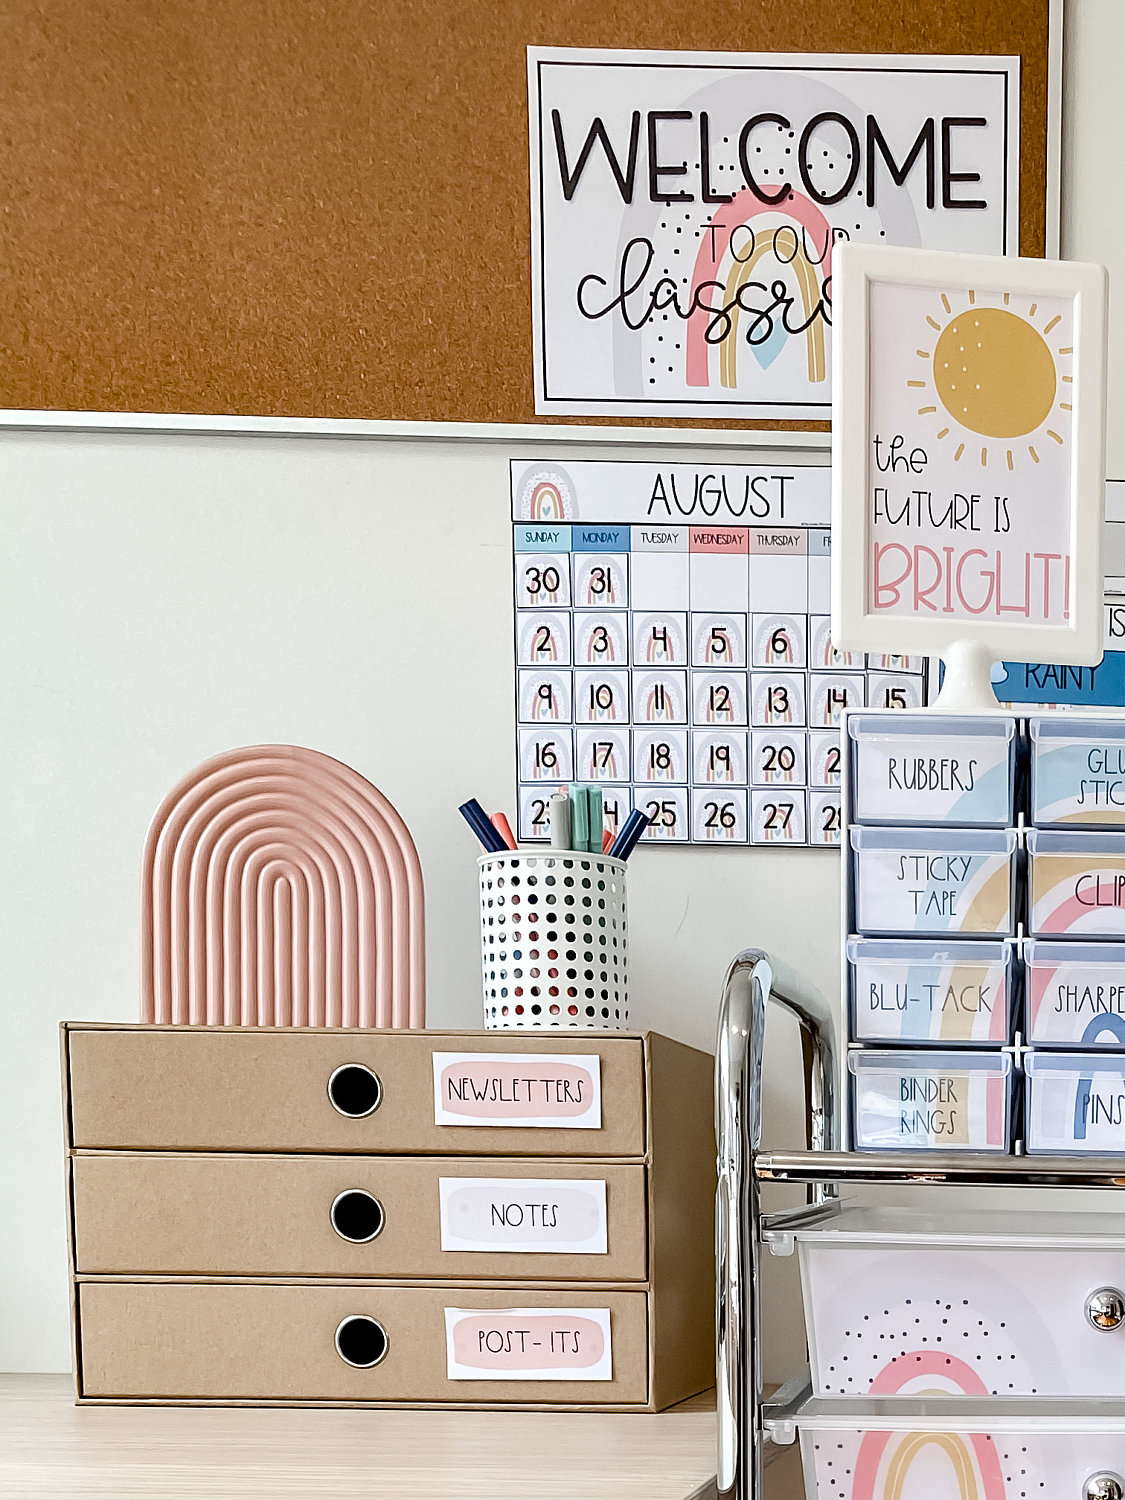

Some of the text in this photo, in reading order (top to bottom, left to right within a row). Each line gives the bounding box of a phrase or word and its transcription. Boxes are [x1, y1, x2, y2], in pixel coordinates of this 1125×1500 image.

[551, 109, 988, 209] WELCOME
[699, 224, 756, 264] TO
[872, 434, 928, 474] the
[647, 473, 795, 519] AUGUST
[874, 487, 1011, 533] FUTURE IS
[525, 531, 801, 546] SUNDAY MONDAY TUESDAY WEDNESDAY THURSDAY
[525, 566, 612, 594] 30 31
[873, 541, 1070, 620] BRIGHT!
[536, 625, 788, 654] 2 3 4 5 6
[1025, 662, 1096, 691] RAINY
[537, 684, 907, 714] 9 10 11 12 13 14 15
[535, 742, 557, 768] 16
[592, 742, 614, 768] 17
[650, 743, 671, 770] 18
[710, 745, 730, 771] 19
[762, 745, 796, 772] 20
[888, 758, 977, 792] RUBBERS
[646, 801, 677, 828] 25
[704, 802, 736, 829] 26
[763, 803, 794, 829] 27
[900, 855, 972, 882] STICKY
[908, 890, 957, 916] TAPE
[870, 983, 992, 1013] BLU-TACK
[448, 1077, 584, 1103] NEWSLETTERS
[900, 1077, 958, 1103] BINDER
[900, 1109, 957, 1135] RINGS
[1082, 1093, 1125, 1126] PINS
[491, 1203, 559, 1228] NOTES
